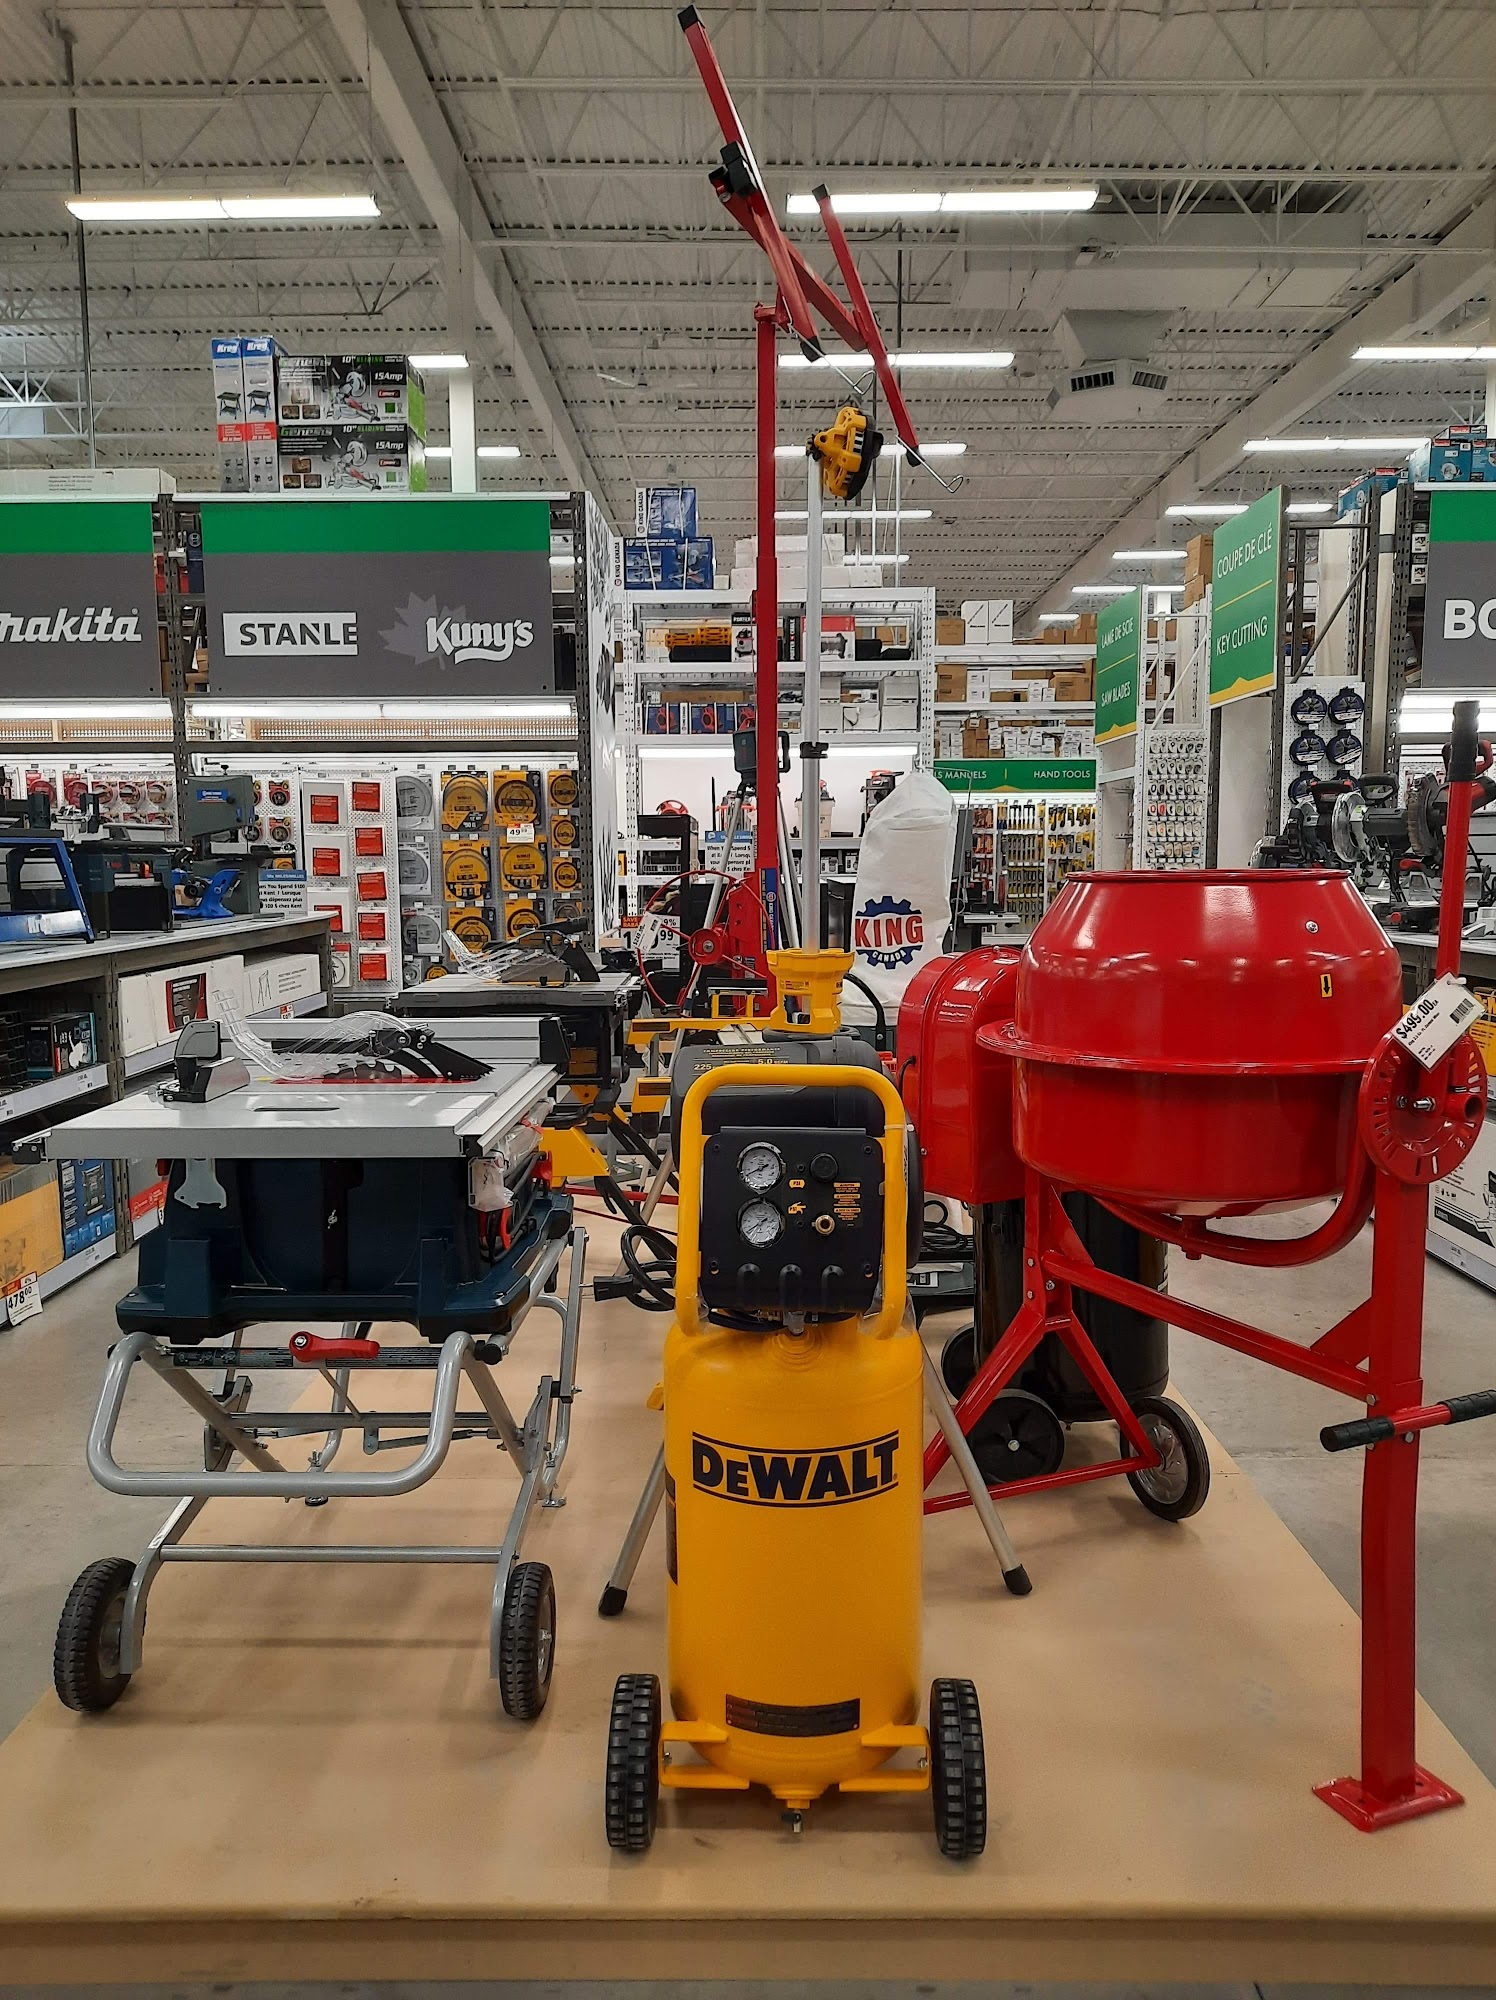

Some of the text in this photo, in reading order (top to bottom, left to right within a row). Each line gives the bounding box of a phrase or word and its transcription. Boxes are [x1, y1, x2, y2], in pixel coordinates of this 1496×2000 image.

[376, 442, 404, 450] 15Amp
[1217, 522, 1272, 578] COUPE DE CLÉ
[0, 607, 142, 642] makita
[1102, 617, 1134, 648] LAME DE SCIE
[1216, 616, 1268, 656] KEY CUTTING
[426, 617, 534, 665] Kuny's
[1102, 681, 1130, 707] SAW BLADES
[945, 770, 987, 779] MANUELS
[1034, 770, 1060, 778] HAND
[1062, 770, 1090, 778] TOOLS
[660, 930, 674, 940] 99
[855, 916, 924, 948] KING
[872, 949, 906, 962] CANADA
[8, 1286, 32, 1309] 478 00
[692, 1436, 899, 1501] DEWALT
